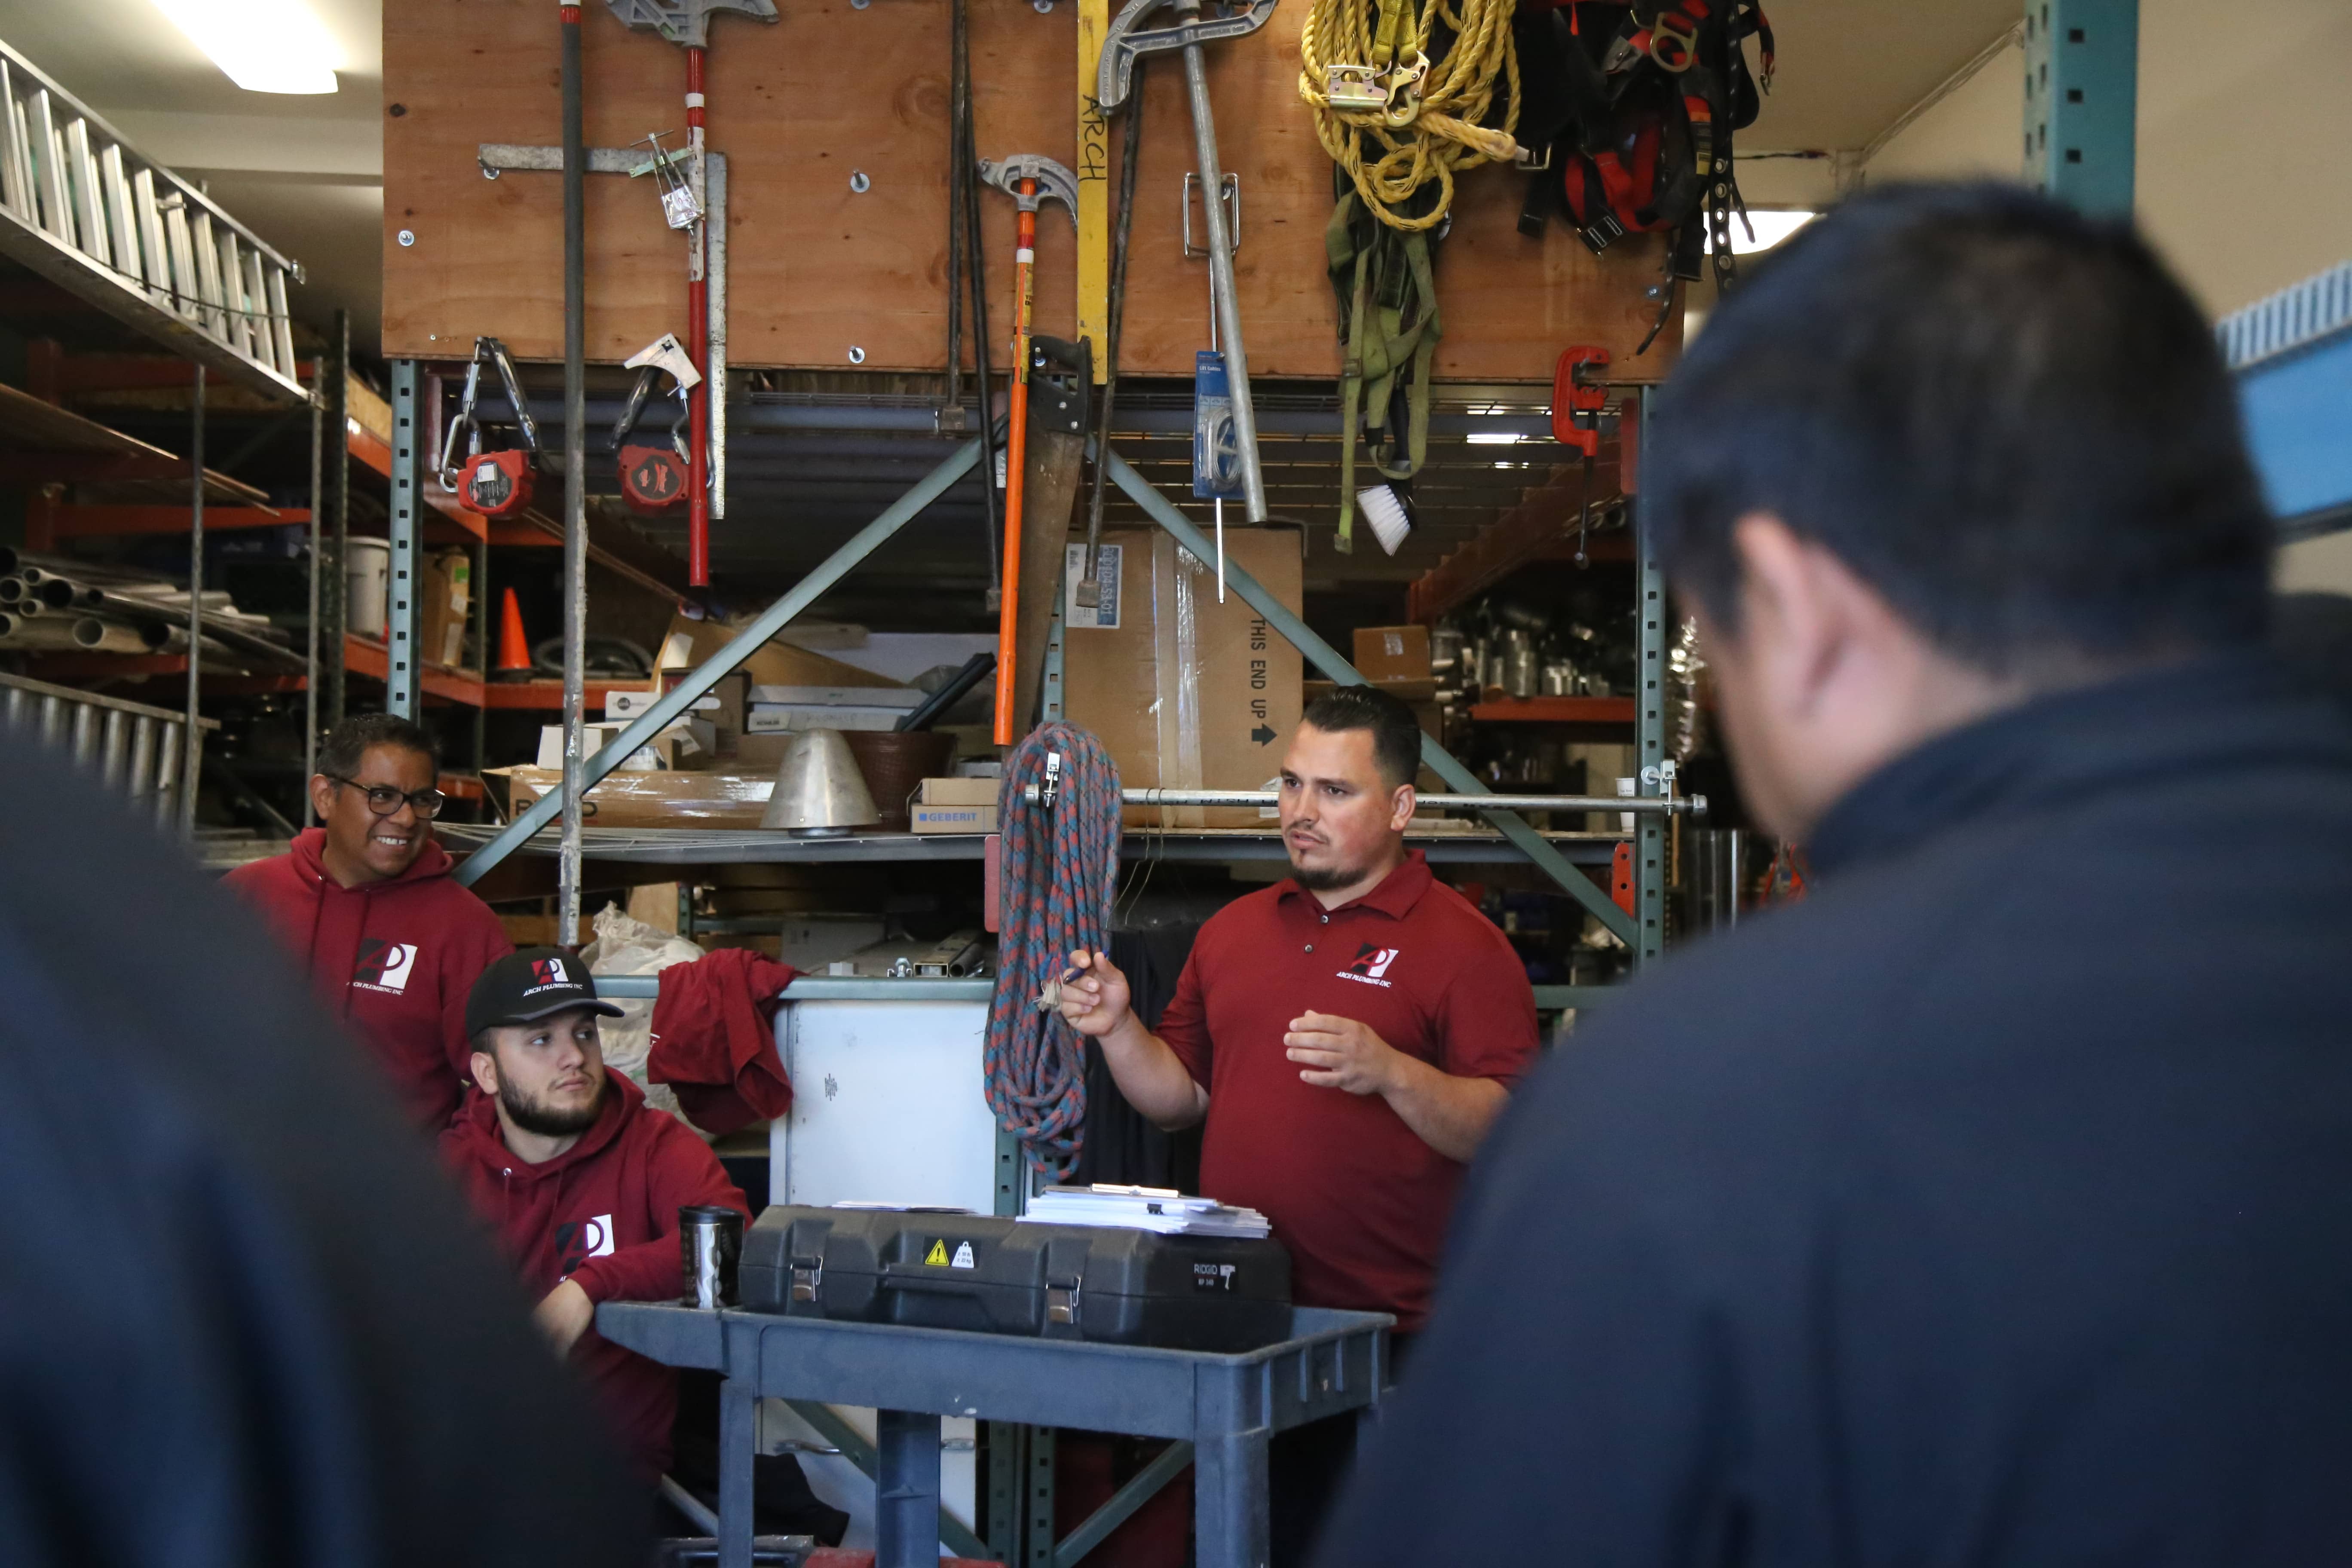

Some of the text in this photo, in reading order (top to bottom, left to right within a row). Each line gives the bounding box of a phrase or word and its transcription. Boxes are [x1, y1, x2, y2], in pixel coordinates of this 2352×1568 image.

[1078, 94, 1107, 182] ARCH
[1251, 618, 1266, 719] THIS END UP
[929, 813, 977, 821] GEBERIT
[1336, 971, 1392, 988] ARCH PLUMBING INC
[362, 983, 392, 993] PLUMBING
[523, 986, 541, 997] ARCH
[542, 983, 573, 991] PLUMBING
[1194, 1263, 1218, 1275] RIDGID
